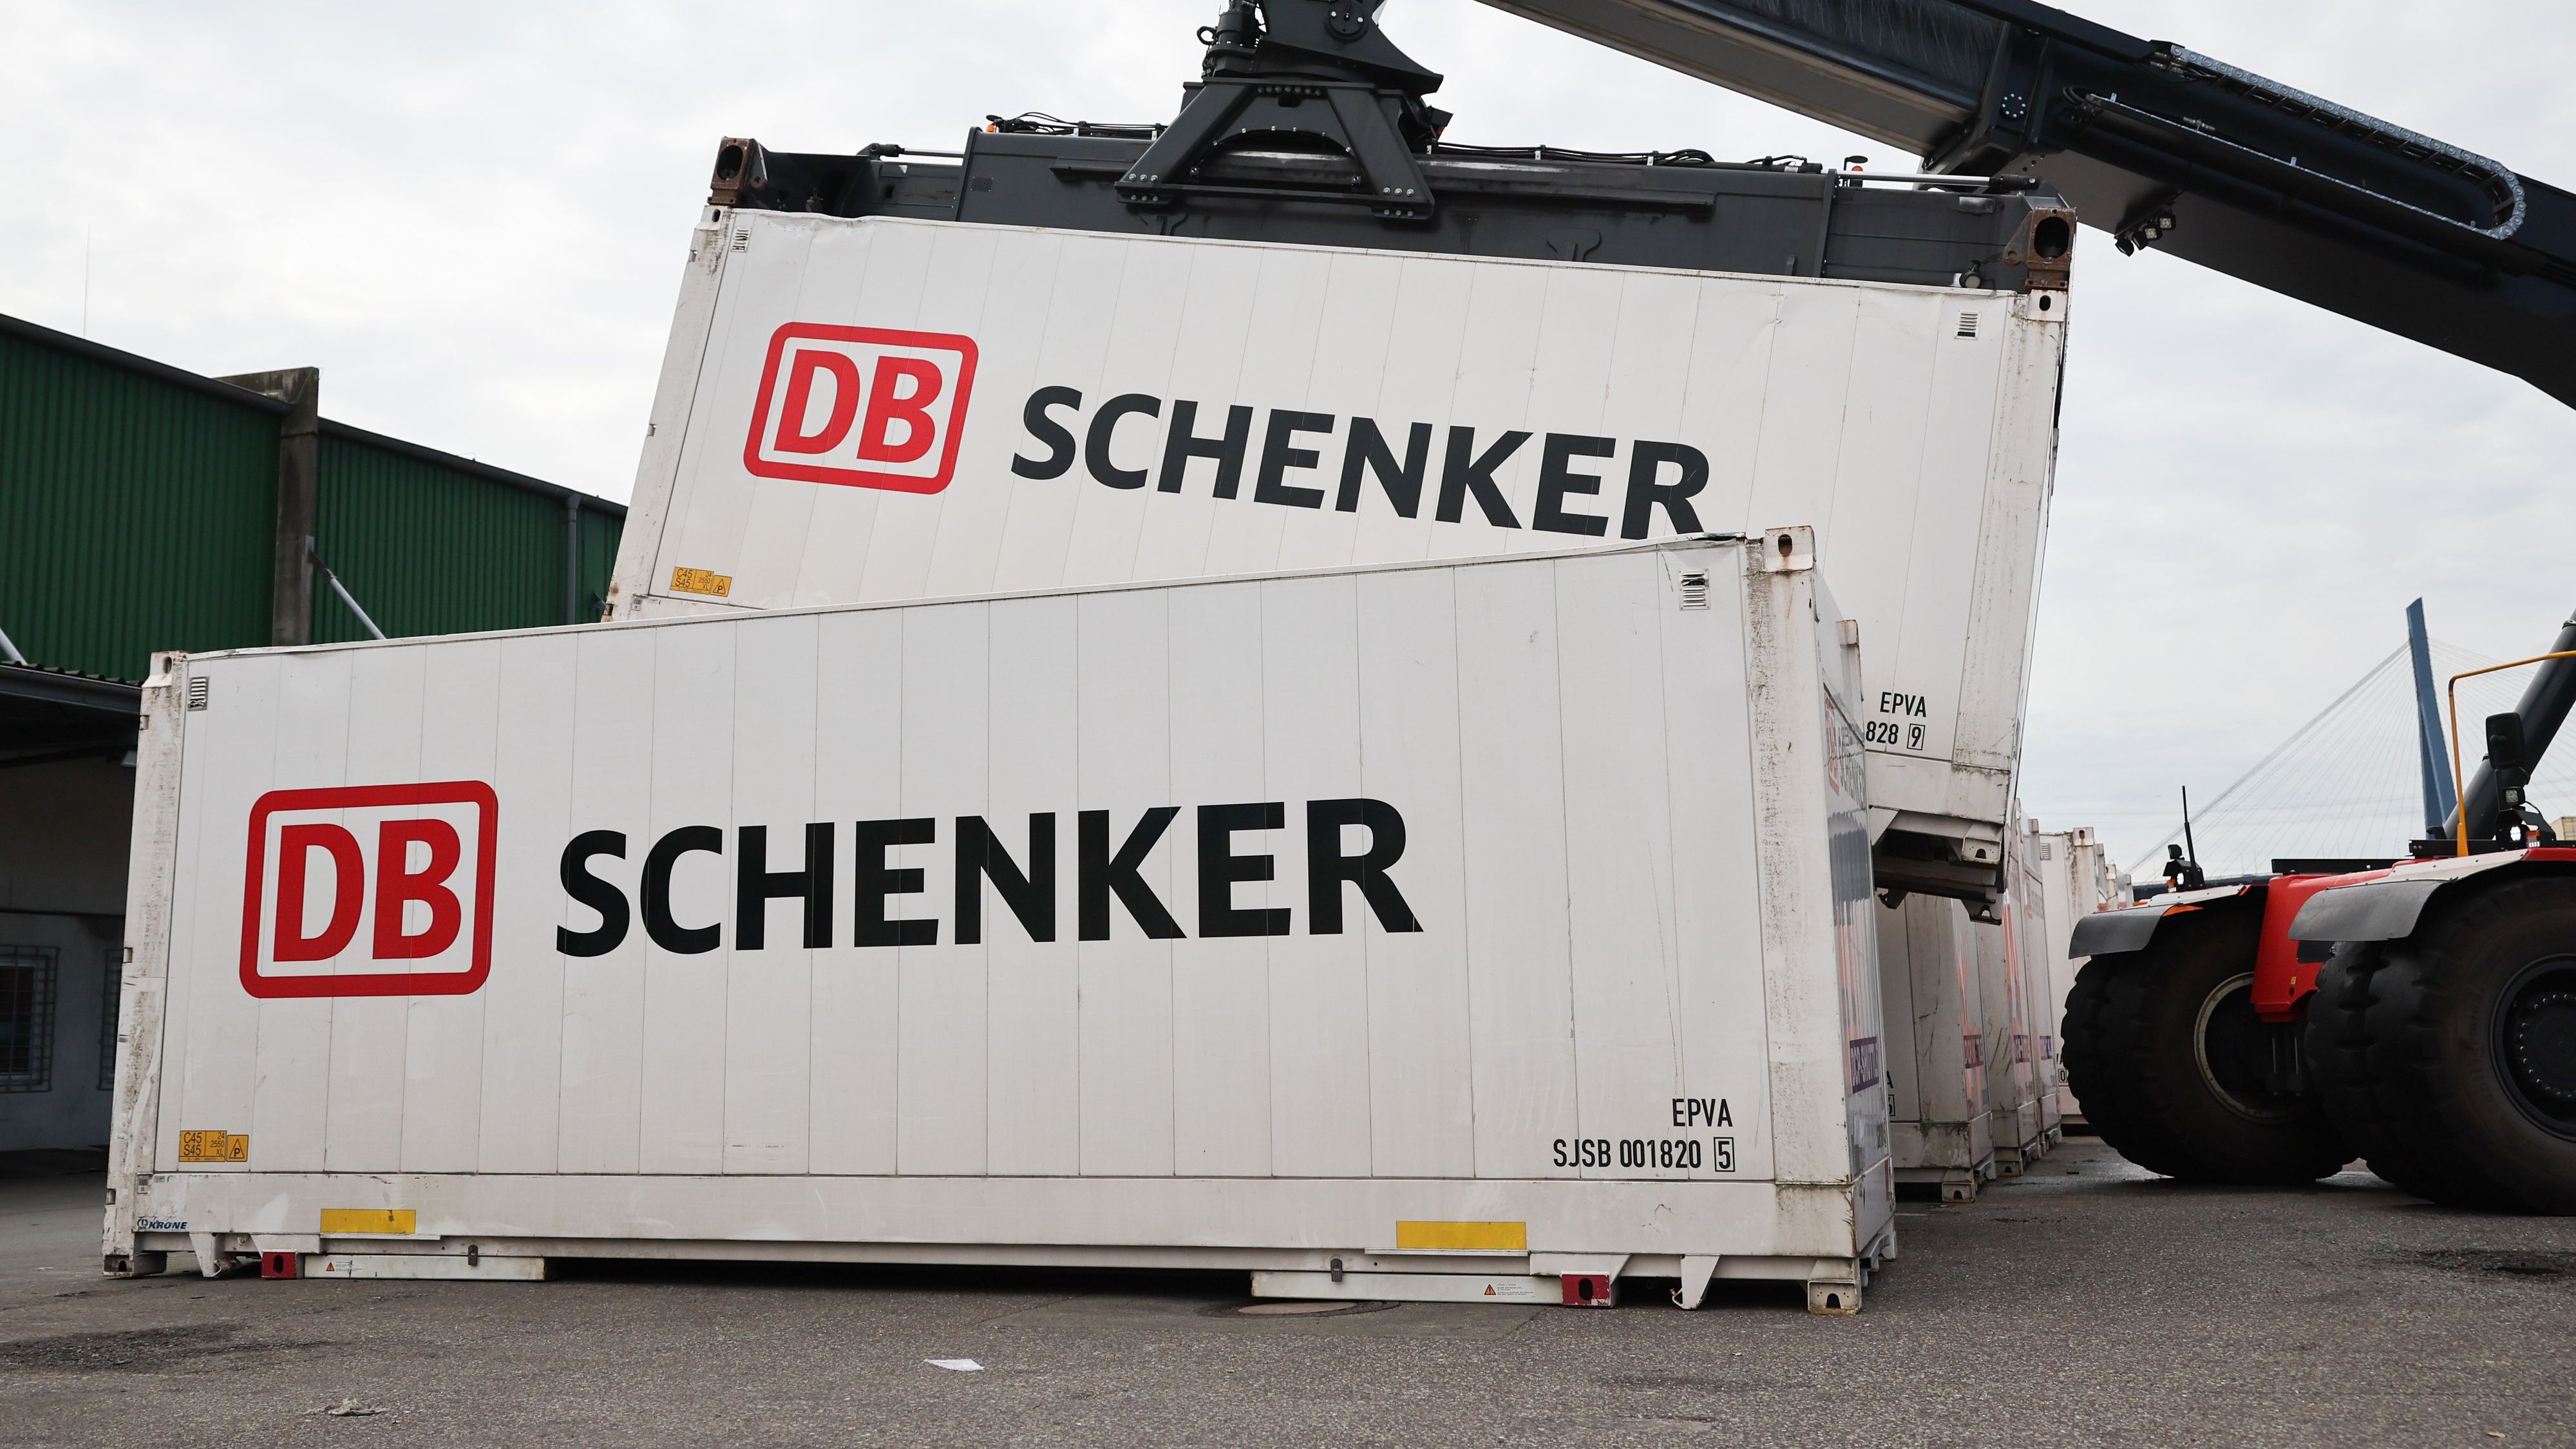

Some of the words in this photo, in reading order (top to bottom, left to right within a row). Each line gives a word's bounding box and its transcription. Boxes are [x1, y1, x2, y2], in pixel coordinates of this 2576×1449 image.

[773, 348, 943, 462] DB
[1010, 386, 1709, 538] SCHENKER
[676, 568, 692, 578] C45
[675, 578, 690, 588] S45
[1880, 692, 1926, 717] EPVA
[1911, 726, 1922, 748] 9
[272, 819, 461, 962] DB
[556, 798, 1414, 958] SCHENKER
[1672, 1098, 1733, 1127] EPVA
[184, 1132, 202, 1144] C45
[218, 1132, 225, 1140] 24
[183, 1144, 202, 1156] S45
[210, 1140, 225, 1148] 2550
[234, 1148, 241, 1157] P
[1553, 1139, 1611, 1168] SJSB
[1620, 1139, 1701, 1168] 001820
[1718, 1141, 1731, 1170] 5
[148, 1220, 188, 1230] KRONE
